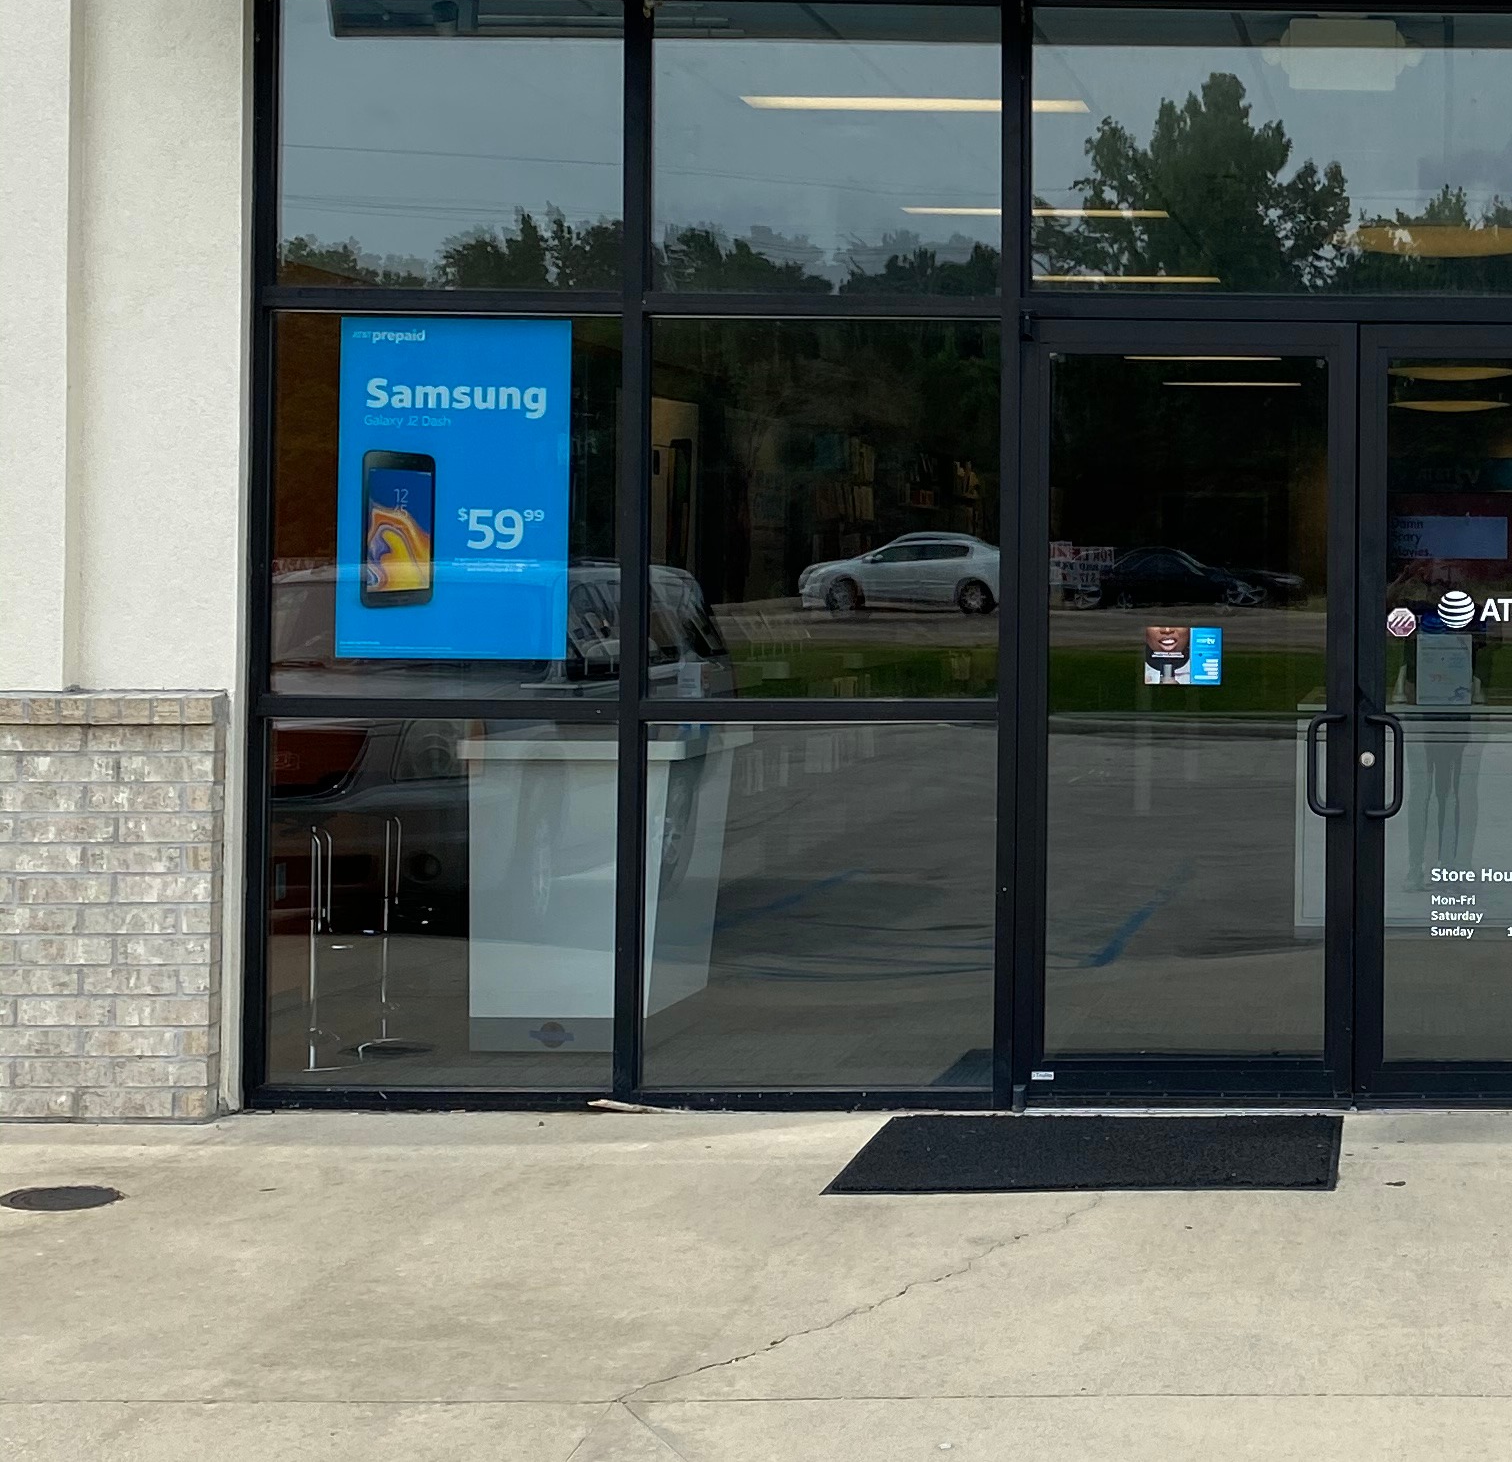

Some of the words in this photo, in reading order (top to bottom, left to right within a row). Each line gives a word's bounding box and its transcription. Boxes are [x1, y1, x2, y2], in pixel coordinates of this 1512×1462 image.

[372, 329, 426, 344] prepaid
[366, 377, 547, 419] Samsung
[364, 414, 403, 428] Galaxy
[422, 415, 452, 427] Dash
[393, 488, 409, 503] 12
[1431, 868, 1476, 882] Store
[1431, 895, 1476, 906] Mon-Fri
[1431, 910, 1483, 924] Saturday
[1430, 926, 1475, 939] Sunday
